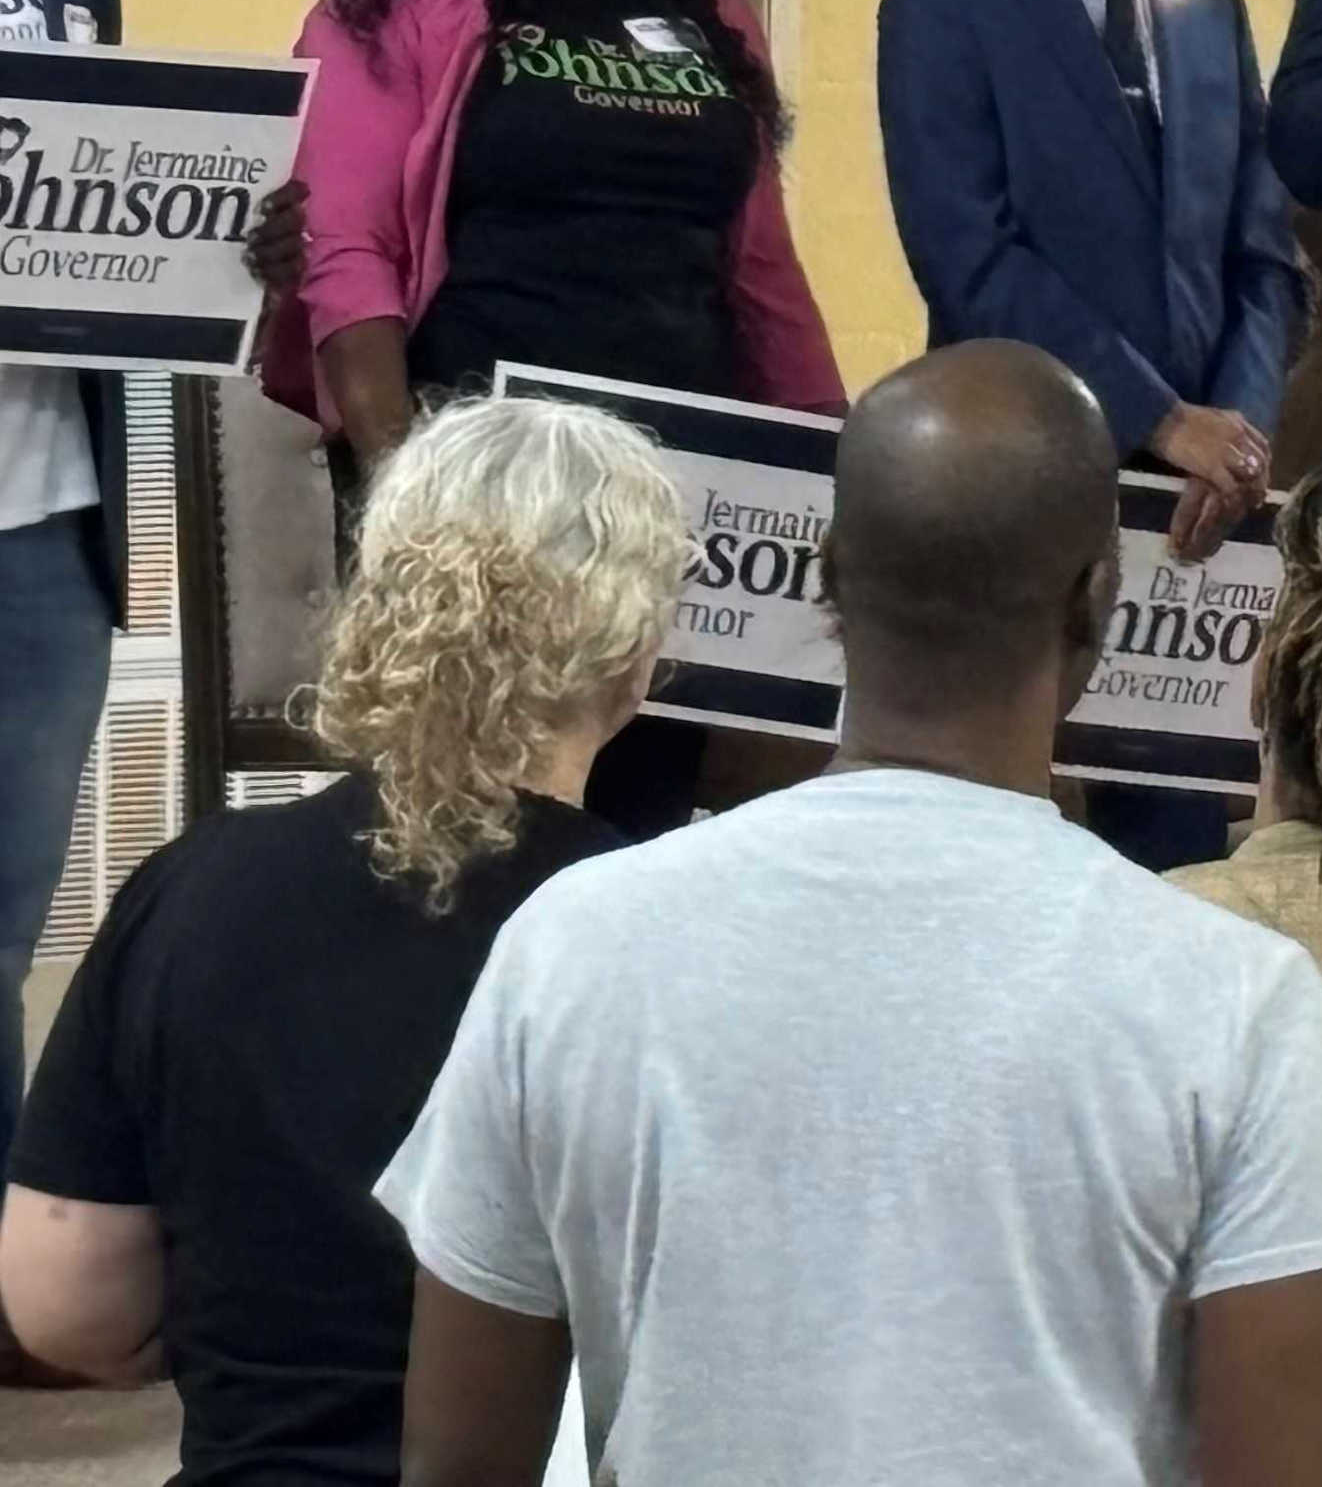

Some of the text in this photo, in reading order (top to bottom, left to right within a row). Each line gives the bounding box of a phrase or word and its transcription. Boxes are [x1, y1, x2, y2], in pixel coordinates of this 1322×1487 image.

[573, 85, 701, 116] Governor
[69, 137, 268, 184] Dr. Jermaine
[0, 150, 250, 242] hnson
[1, 235, 169, 283] Governor
[701, 487, 828, 542] Jermai
[1194, 569, 1276, 611] Jerma
